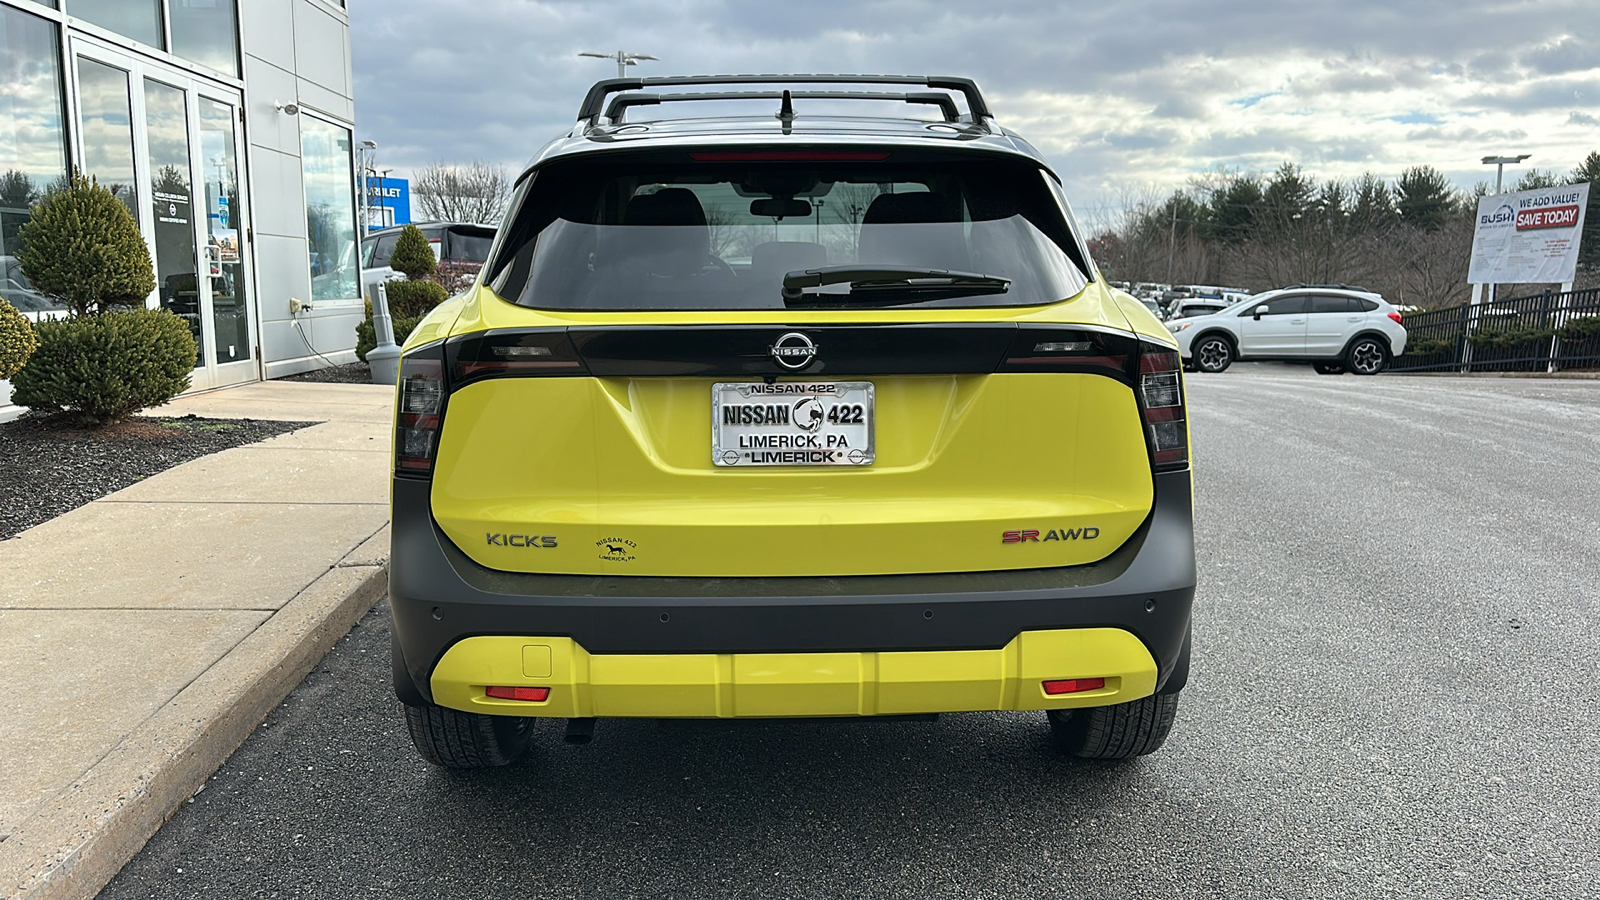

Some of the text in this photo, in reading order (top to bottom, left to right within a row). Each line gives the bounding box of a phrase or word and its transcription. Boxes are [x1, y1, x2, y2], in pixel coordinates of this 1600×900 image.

[1519, 193, 1580, 208] WE ADD VALUE!
[1481, 212, 1514, 224] BUSH
[1517, 213, 1541, 227] SAVE
[1543, 209, 1577, 224] TODAY
[771, 348, 817, 356] NISSAN
[751, 384, 836, 393] NISSAN 422
[723, 404, 864, 425] NISSAN 422
[739, 435, 849, 449] LIMERICK, PA
[751, 451, 836, 463] LIMERICK
[486, 532, 558, 548] KICKS
[1002, 526, 1100, 544] SR AWD
[596, 537, 637, 548] NISSAN 422
[598, 554, 628, 562] LIMERICK,
